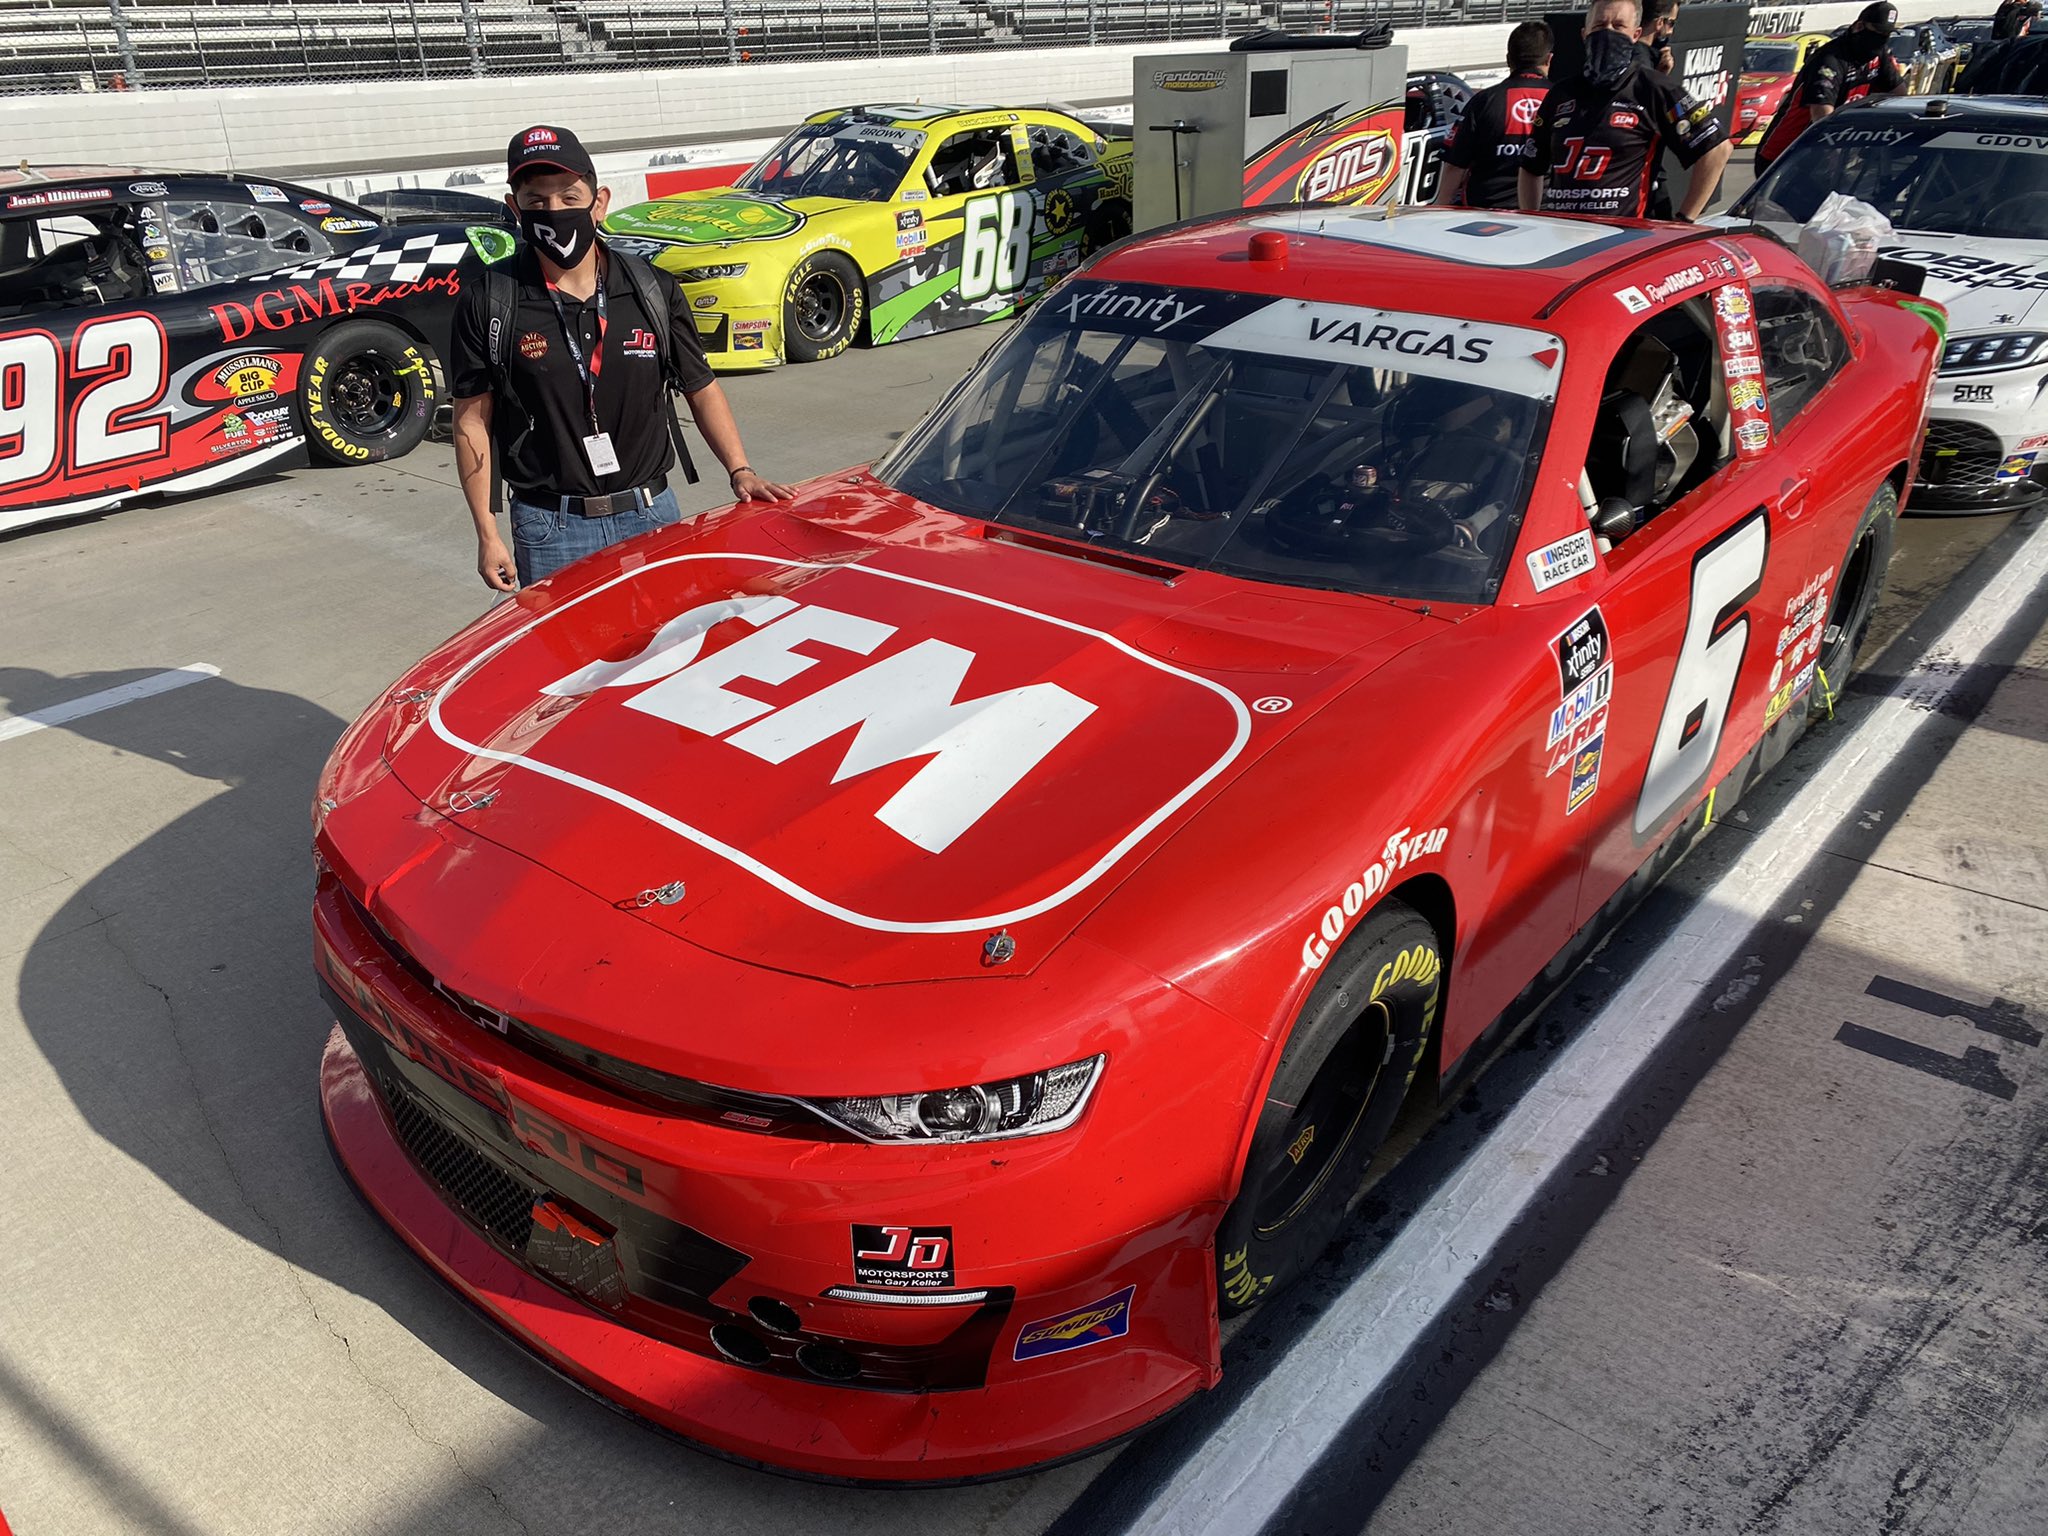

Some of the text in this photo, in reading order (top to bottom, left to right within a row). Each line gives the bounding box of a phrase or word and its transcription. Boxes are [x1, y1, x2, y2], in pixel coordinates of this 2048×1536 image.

[1614, 115, 1634, 124] SEM
[527, 131, 553, 143] SEM
[859, 128, 906, 139] BROWN
[1817, 126, 1914, 146] xfinity
[1307, 136, 1389, 201] BMS
[1553, 137, 1613, 180] JD
[9, 189, 111, 208] Josh Williams
[1099, 187, 1119, 198] Hard
[1579, 201, 1619, 210] KELLER
[327, 221, 352, 232] STAR
[899, 213, 920, 227] xfinity
[896, 232, 918, 244] Mobil
[959, 189, 1035, 301] 68
[900, 245, 926, 258] ARP
[155, 274, 174, 287] WIX
[786, 259, 813, 303] EAGLE
[1666, 266, 1704, 294] VARGAS
[208, 268, 461, 344] DGM Racing
[1058, 285, 1206, 331] xfinity
[734, 320, 768, 330] SIMPSON
[521, 341, 548, 352] AUCTION
[623, 328, 656, 350] JD
[1307, 316, 1494, 365] VARGAS
[1727, 330, 1754, 348] SEM
[623, 349, 656, 357] MOTORSPORTS
[239, 371, 260, 383] BIG
[403, 346, 434, 400] EAGLE
[240, 380, 264, 393] CUP
[1953, 384, 1995, 403] SHR
[0, 310, 168, 490] 92
[237, 392, 276, 406] APPLE SAUCE
[307, 356, 369, 459] GOODYEAR
[225, 430, 248, 439] FUEL
[210, 438, 252, 453] SILVERTON
[1549, 536, 1587, 563] NASCAR
[1543, 554, 1590, 582] RACE CAR
[1566, 632, 1602, 678] xfinity
[1634, 506, 1769, 848] 6
[1550, 672, 1608, 739] Mobil 1
[539, 594, 1098, 855] SEM
[1557, 705, 1608, 760] ARP
[1570, 772, 1597, 800] ROOKIE
[1302, 827, 1449, 970] GOODYEAR
[857, 1226, 950, 1269] JD
[857, 1269, 949, 1279] MOTORSPORTS
[884, 1279, 909, 1287] Gary
[911, 1279, 942, 1287] Keller
[1022, 1302, 1125, 1344] SUNOCO
